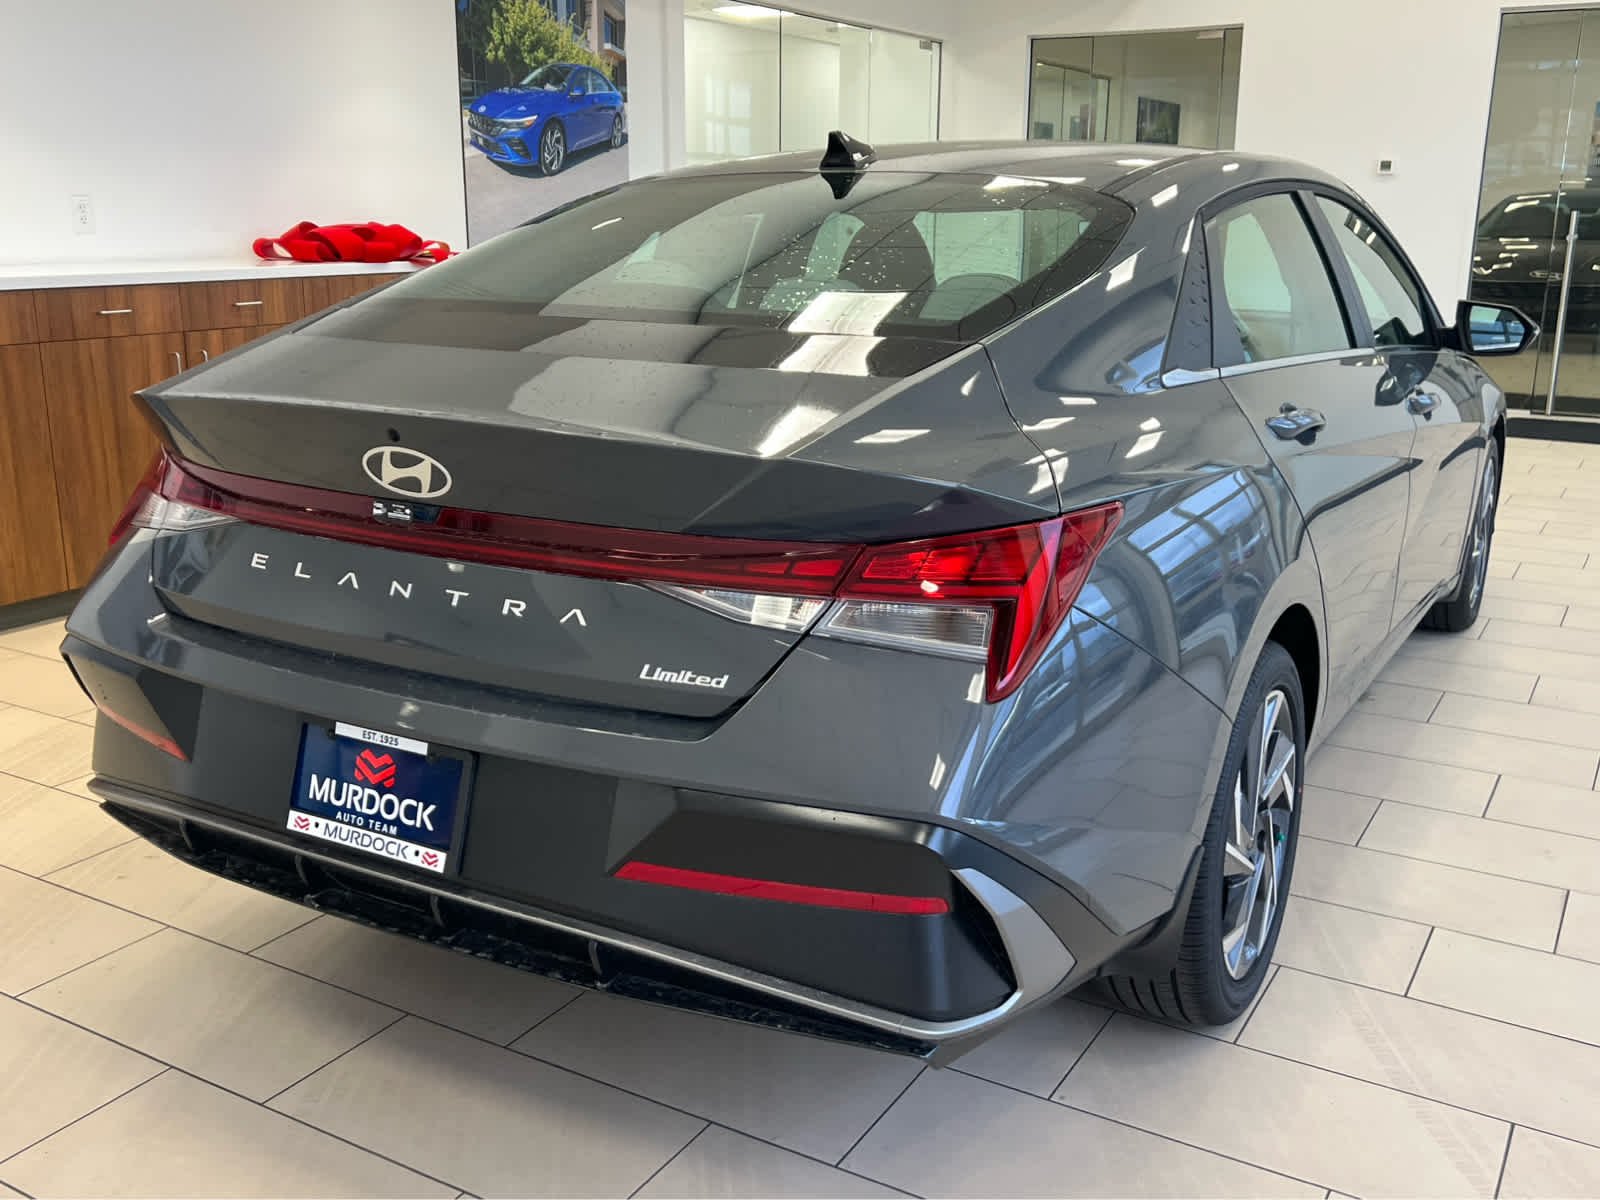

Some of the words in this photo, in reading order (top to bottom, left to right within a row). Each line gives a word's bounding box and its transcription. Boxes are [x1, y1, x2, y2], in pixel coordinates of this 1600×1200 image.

[250, 553, 588, 627] ELANTRA
[639, 663, 729, 688] Limited
[362, 730, 380, 743] EST.
[380, 734, 399, 746] 1925
[309, 774, 436, 831] MURDOCK
[336, 811, 365, 826] AUTO
[369, 819, 398, 836] TEAM
[323, 823, 409, 859] MURDOCK
